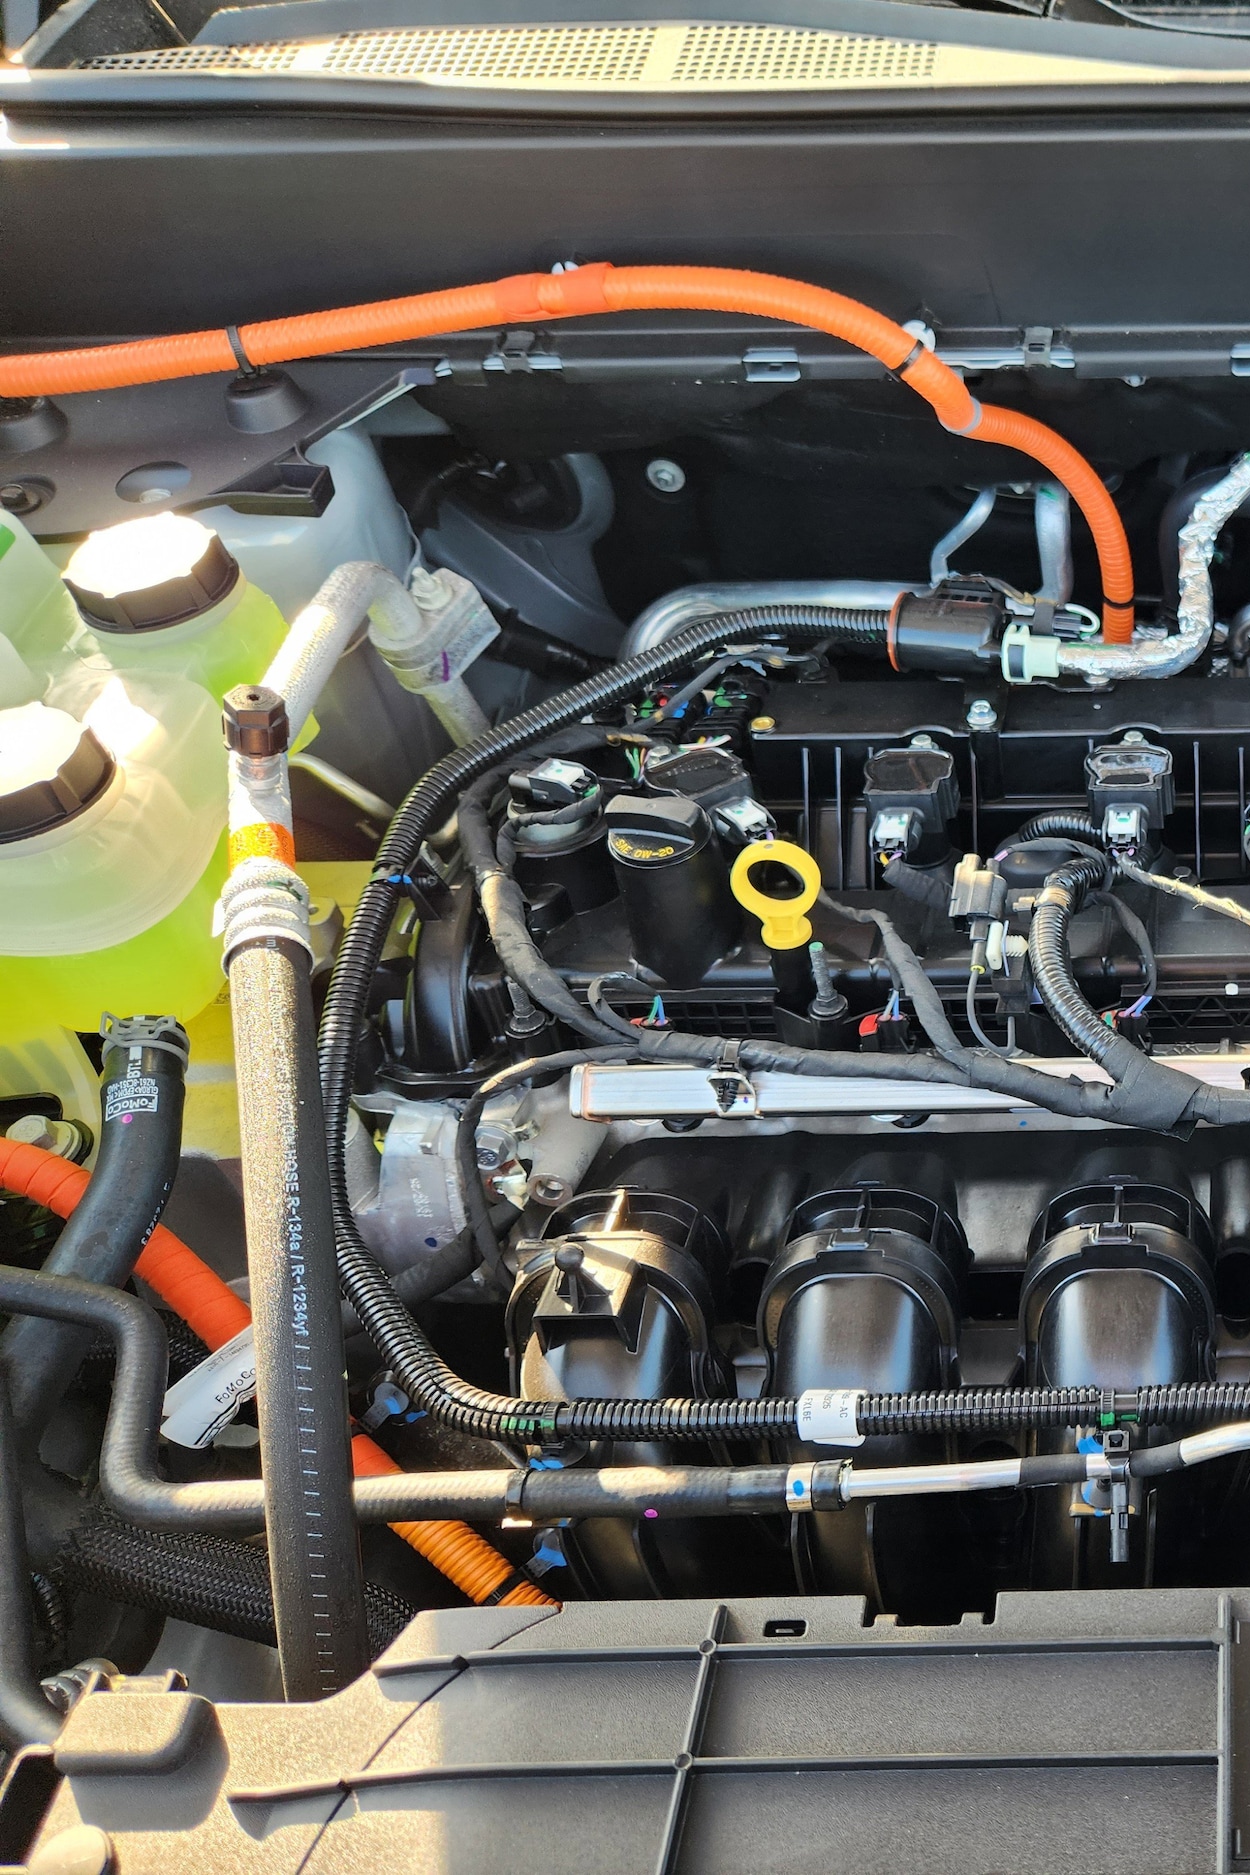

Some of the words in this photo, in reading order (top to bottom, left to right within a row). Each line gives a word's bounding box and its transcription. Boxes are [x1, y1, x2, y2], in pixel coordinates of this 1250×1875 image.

[615, 838, 633, 854] SAE
[633, 846, 675, 859] 0W-20
[127, 1059, 141, 1079] BTL
[108, 1096, 155, 1115] FoMoCo
[284, 1149, 300, 1191] HOSE
[287, 1195, 302, 1252] R-134a
[291, 1265, 309, 1338] R-1234yf
[215, 1367, 256, 1404] FoMoCo
